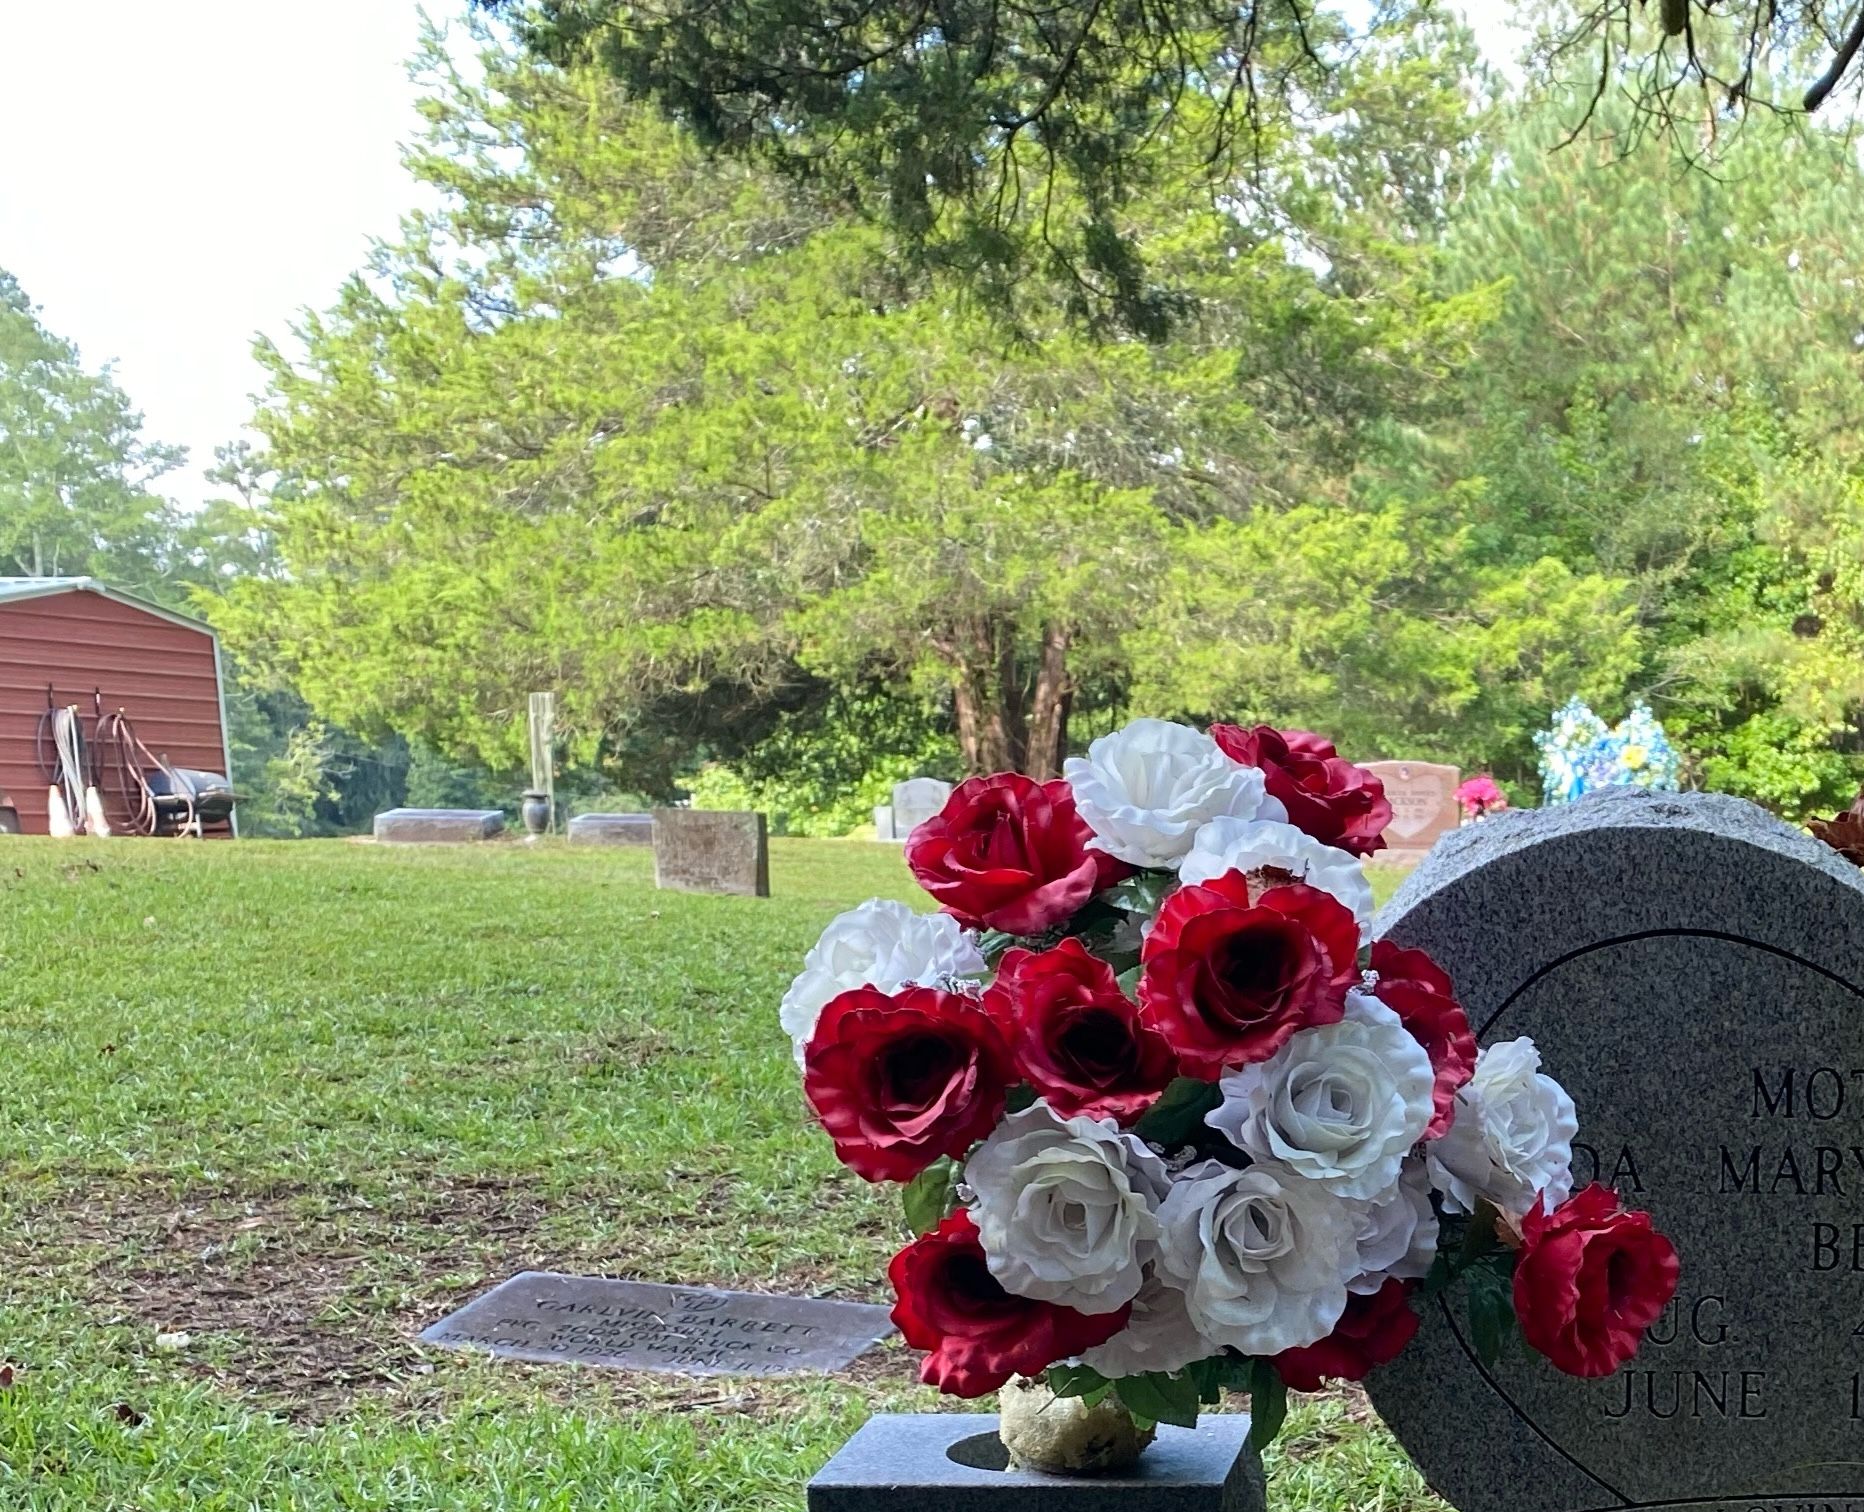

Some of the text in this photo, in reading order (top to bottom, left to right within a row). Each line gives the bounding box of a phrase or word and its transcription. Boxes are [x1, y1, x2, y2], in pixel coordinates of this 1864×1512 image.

[551, 1332, 635, 1349] WORLD
[1647, 1295, 1740, 1346] UG.
[1604, 1370, 1767, 1418] JUNE
